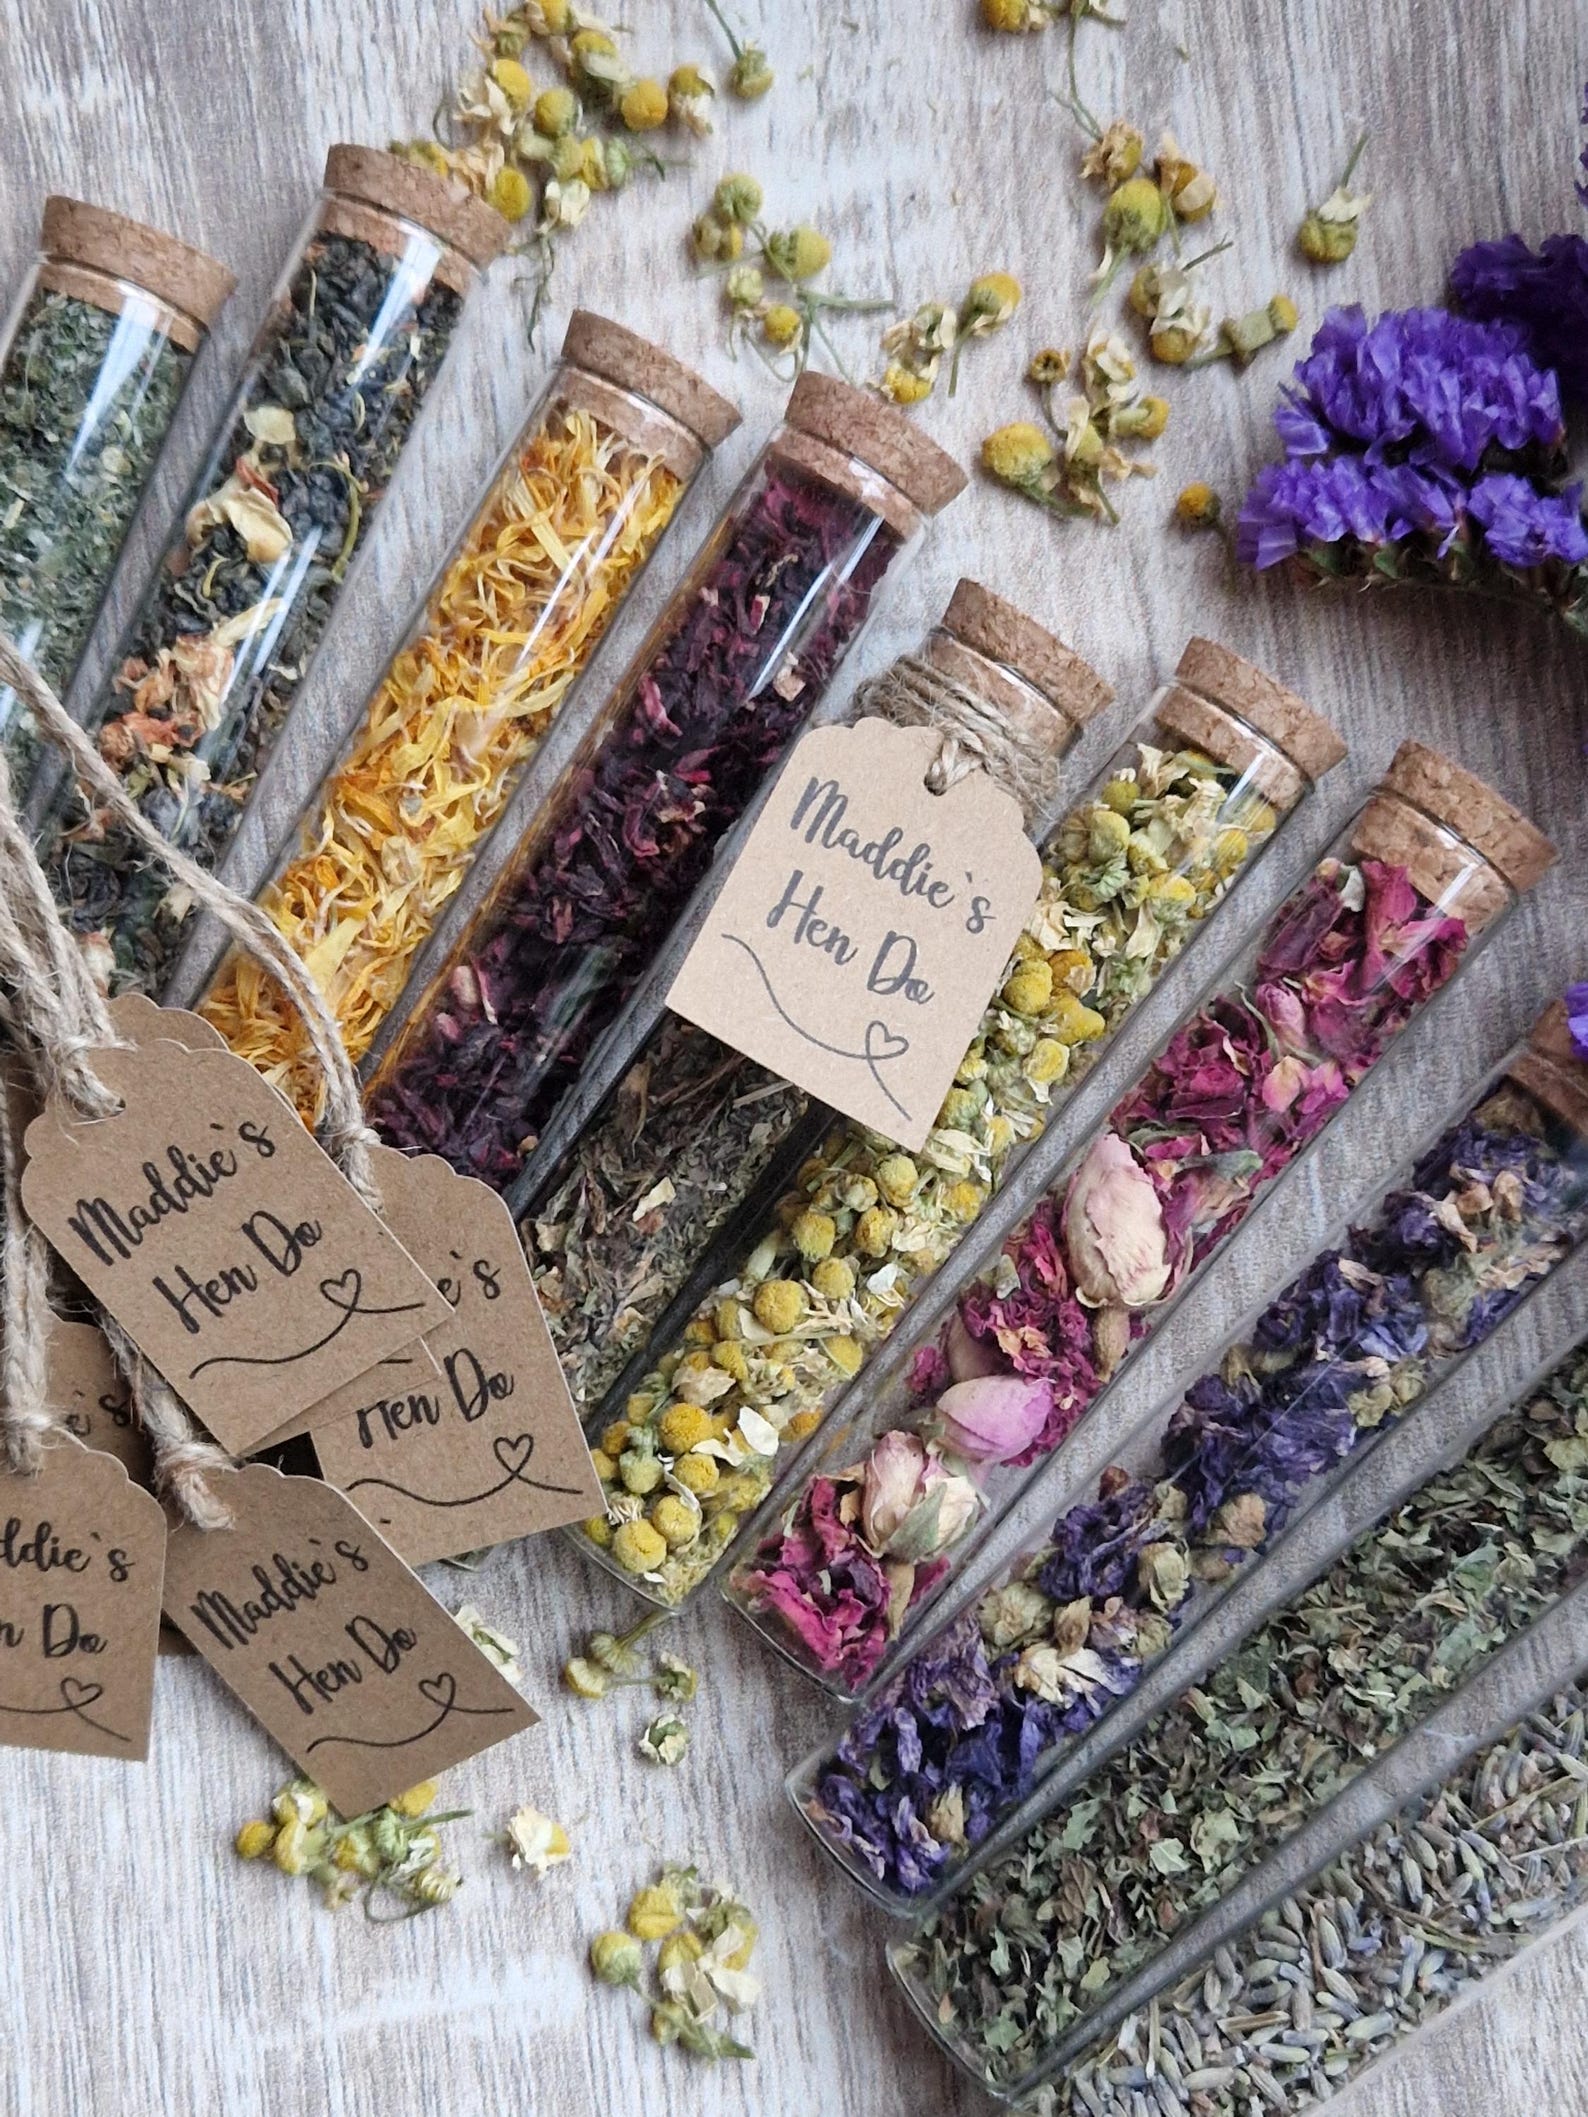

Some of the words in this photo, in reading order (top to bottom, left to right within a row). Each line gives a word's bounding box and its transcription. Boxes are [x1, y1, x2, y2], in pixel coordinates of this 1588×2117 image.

[766, 869, 858, 966] Hen
[866, 930, 936, 1004] Do
[152, 1264, 258, 1334] Hen
[241, 1210, 323, 1277] Do
[443, 1348, 514, 1423] Do
[43, 1603, 108, 1658] Do
[268, 1654, 363, 1715] Hen
[345, 1615, 418, 1674] Do
